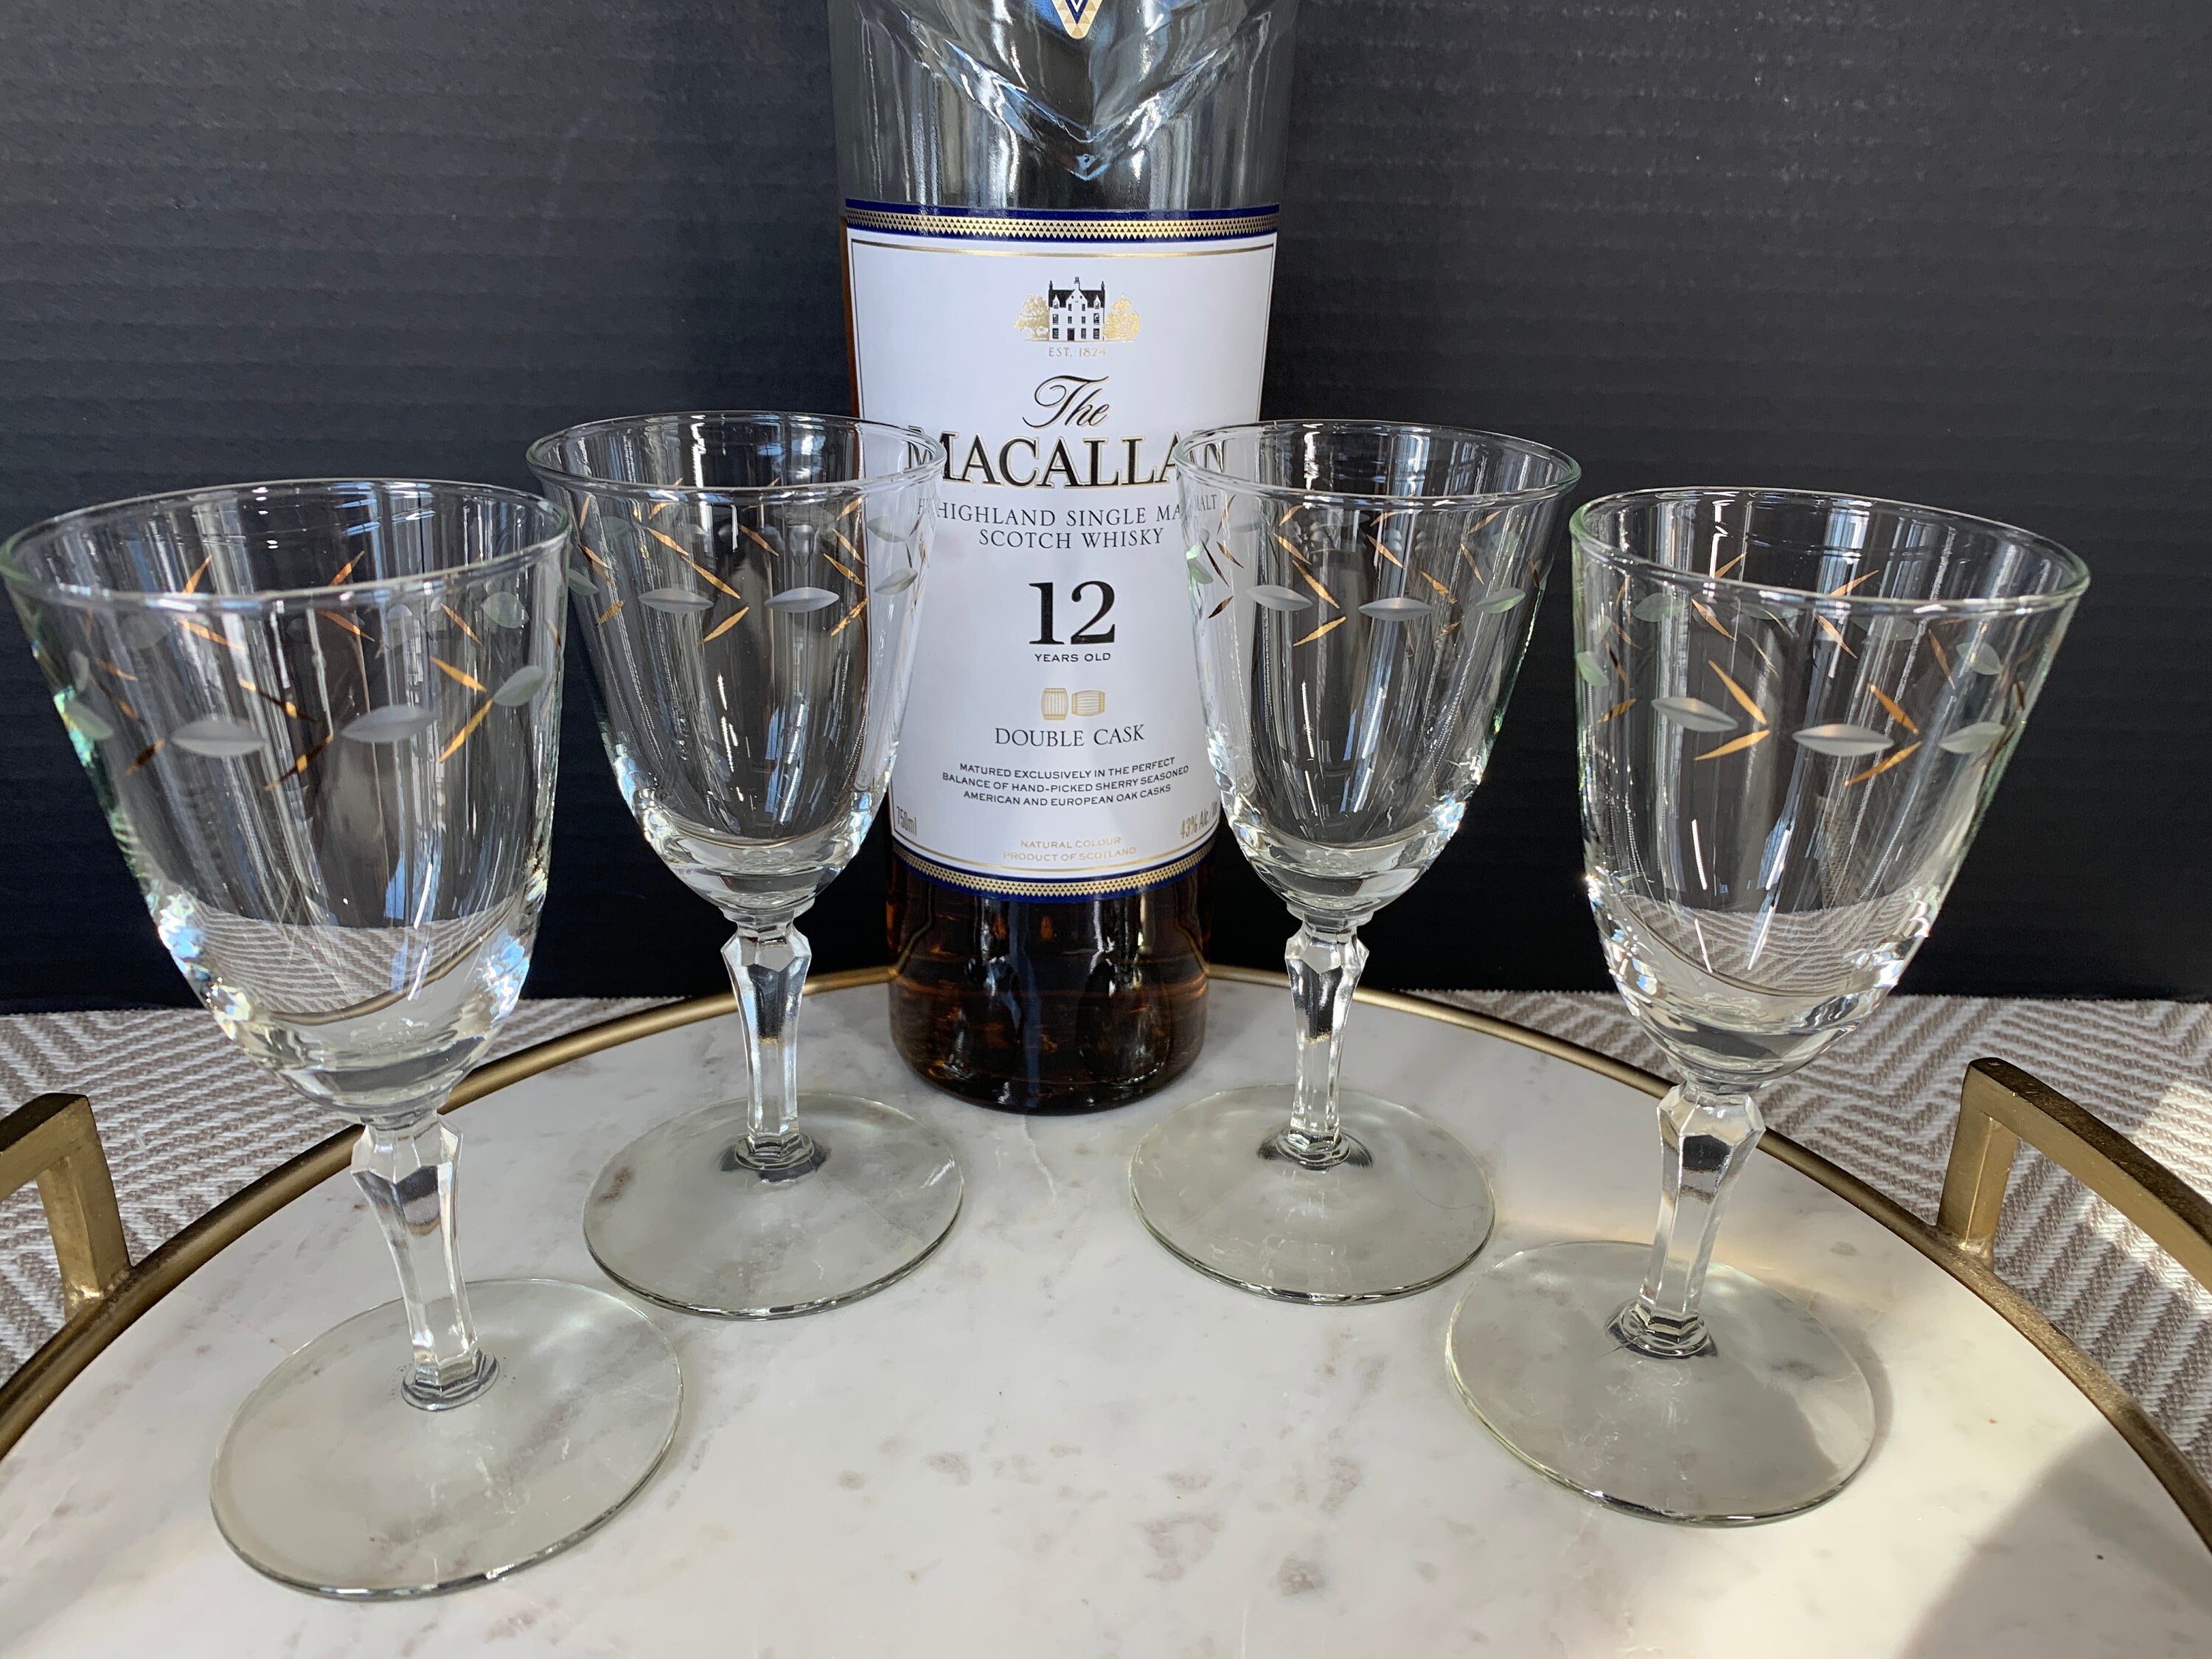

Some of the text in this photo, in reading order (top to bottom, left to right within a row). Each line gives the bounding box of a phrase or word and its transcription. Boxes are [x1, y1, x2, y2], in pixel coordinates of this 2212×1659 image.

[1048, 347, 1074, 358] EST.
[1022, 375, 1110, 429] The
[938, 502, 1056, 526] HIGHLAND
[1066, 507, 1147, 526] SINGLE
[978, 528, 1164, 549] SCOTCH WHISKY
[1029, 580, 1116, 645] 12
[1034, 653, 1111, 663] YEARS OLD
[995, 724, 1145, 747] DOUBLE CASK
[942, 765, 1189, 793] BALANCE OF HAND-PICKED SHERRY SEASONED
[960, 757, 1175, 779] MATURED EXCLUSIVELY IN THE PERFECT
[963, 784, 1172, 807] AMERICAN AND EUROPEAN OAK CASKS
[896, 805, 917, 836] 750ml
[1180, 813, 1197, 839] 43%
[1003, 846, 1137, 861] PRODUCT OF SCOTLAND
[1020, 836, 1121, 849] NATURAL COLOUR
